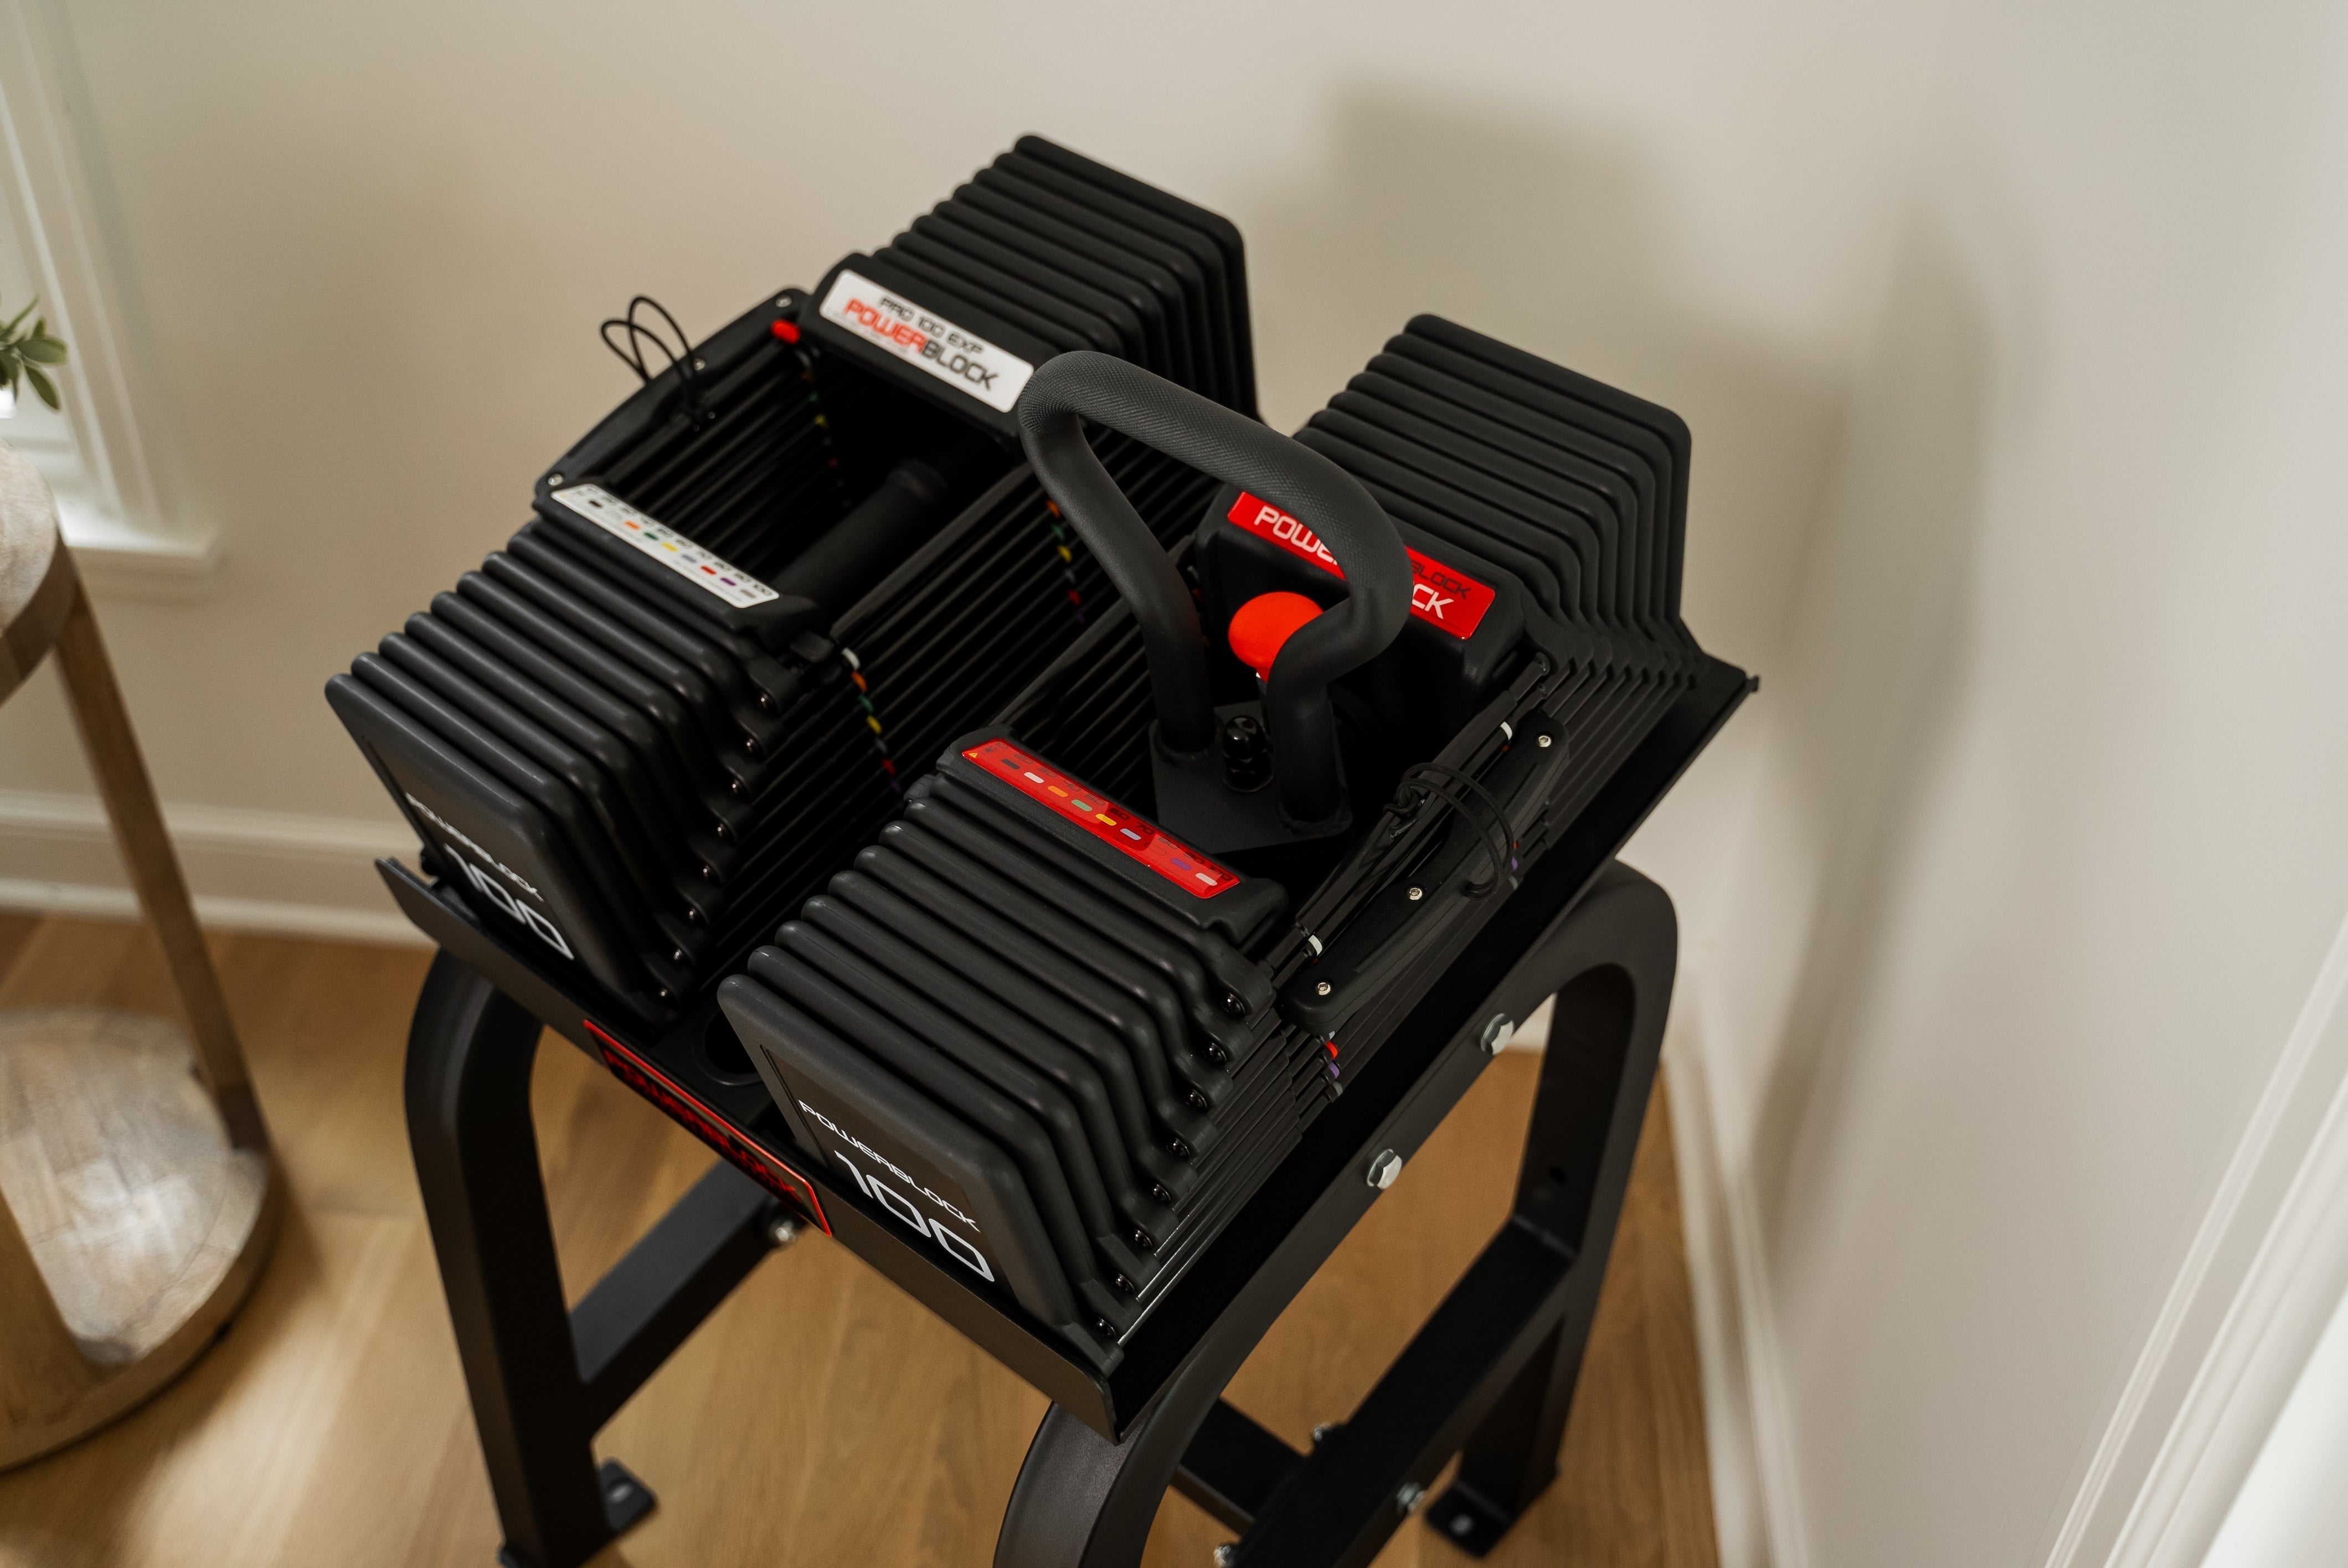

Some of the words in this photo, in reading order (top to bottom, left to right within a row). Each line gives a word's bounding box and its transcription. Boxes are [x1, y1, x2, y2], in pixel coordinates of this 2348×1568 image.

[843, 297, 1000, 391] POWERBLOCK
[879, 298, 914, 321] PRO
[917, 315, 946, 338] 100
[946, 332, 983, 354] EXP
[1109, 807, 1130, 821] 60
[1134, 822, 1155, 835] 70
[1207, 865, 1233, 881] 100
[444, 843, 575, 961] 100
[798, 1099, 981, 1233] POWERBLOCK
[834, 1149, 995, 1282] 100
